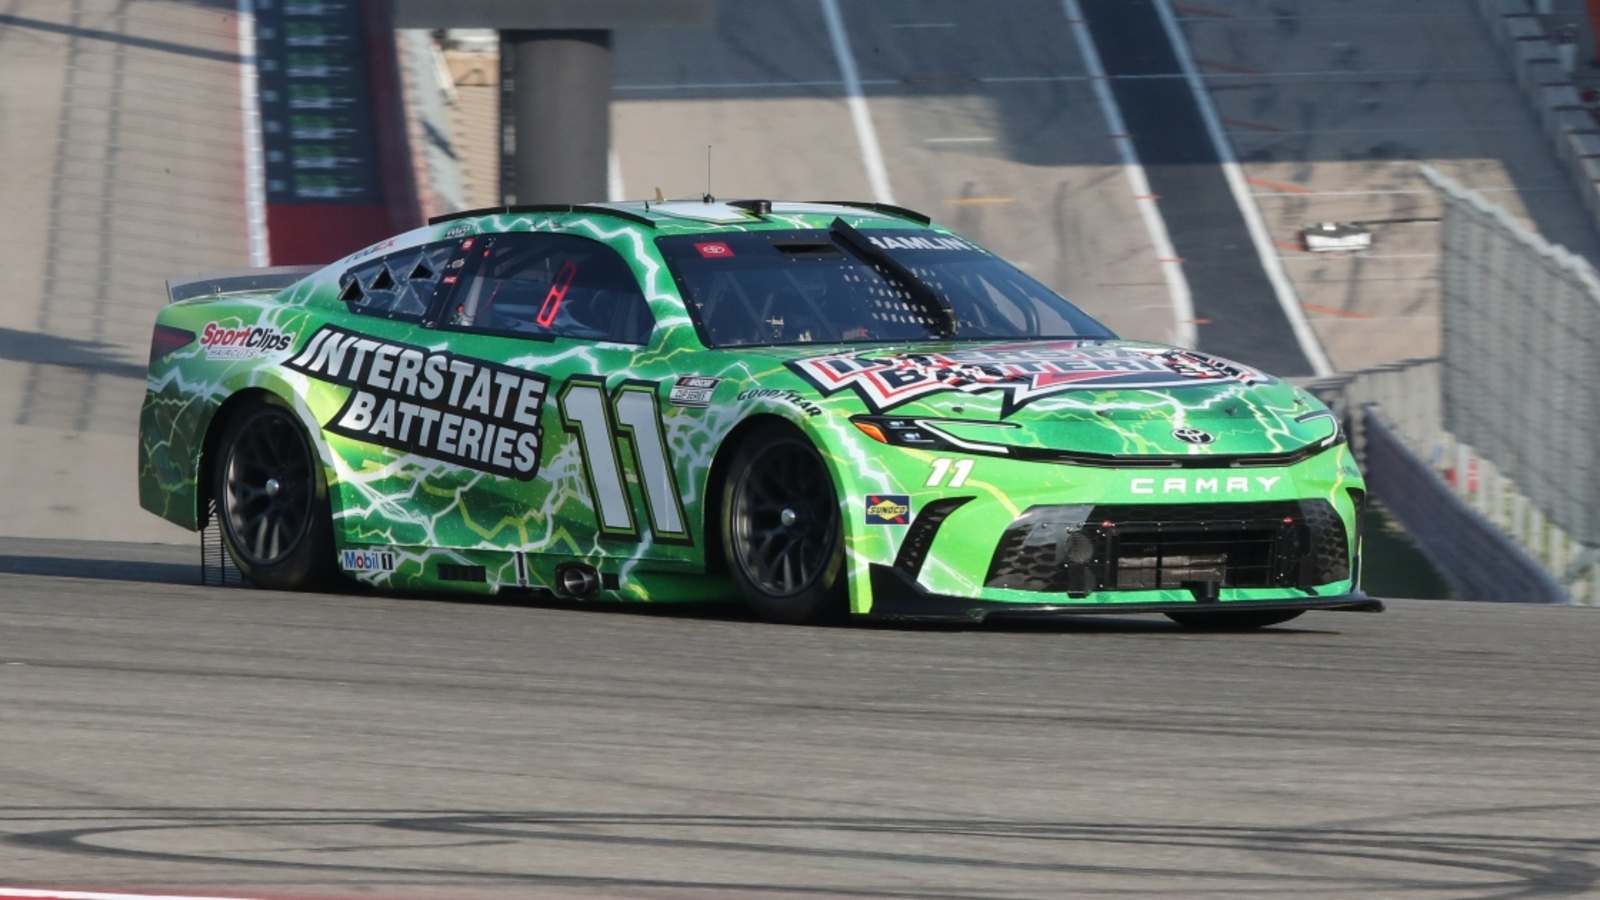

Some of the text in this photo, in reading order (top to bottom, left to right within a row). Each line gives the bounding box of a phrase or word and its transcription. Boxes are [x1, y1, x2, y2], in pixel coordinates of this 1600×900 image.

[209, 349, 257, 358] HAIRCUTS
[291, 328, 545, 427] INTERSTATE
[338, 390, 539, 473] BATTERIES
[556, 374, 693, 546] 11
[922, 457, 976, 489] 11
[1130, 476, 1280, 494] CAMRY
[868, 505, 908, 515] SUNOCO
[344, 551, 394, 570] Mobil 1
